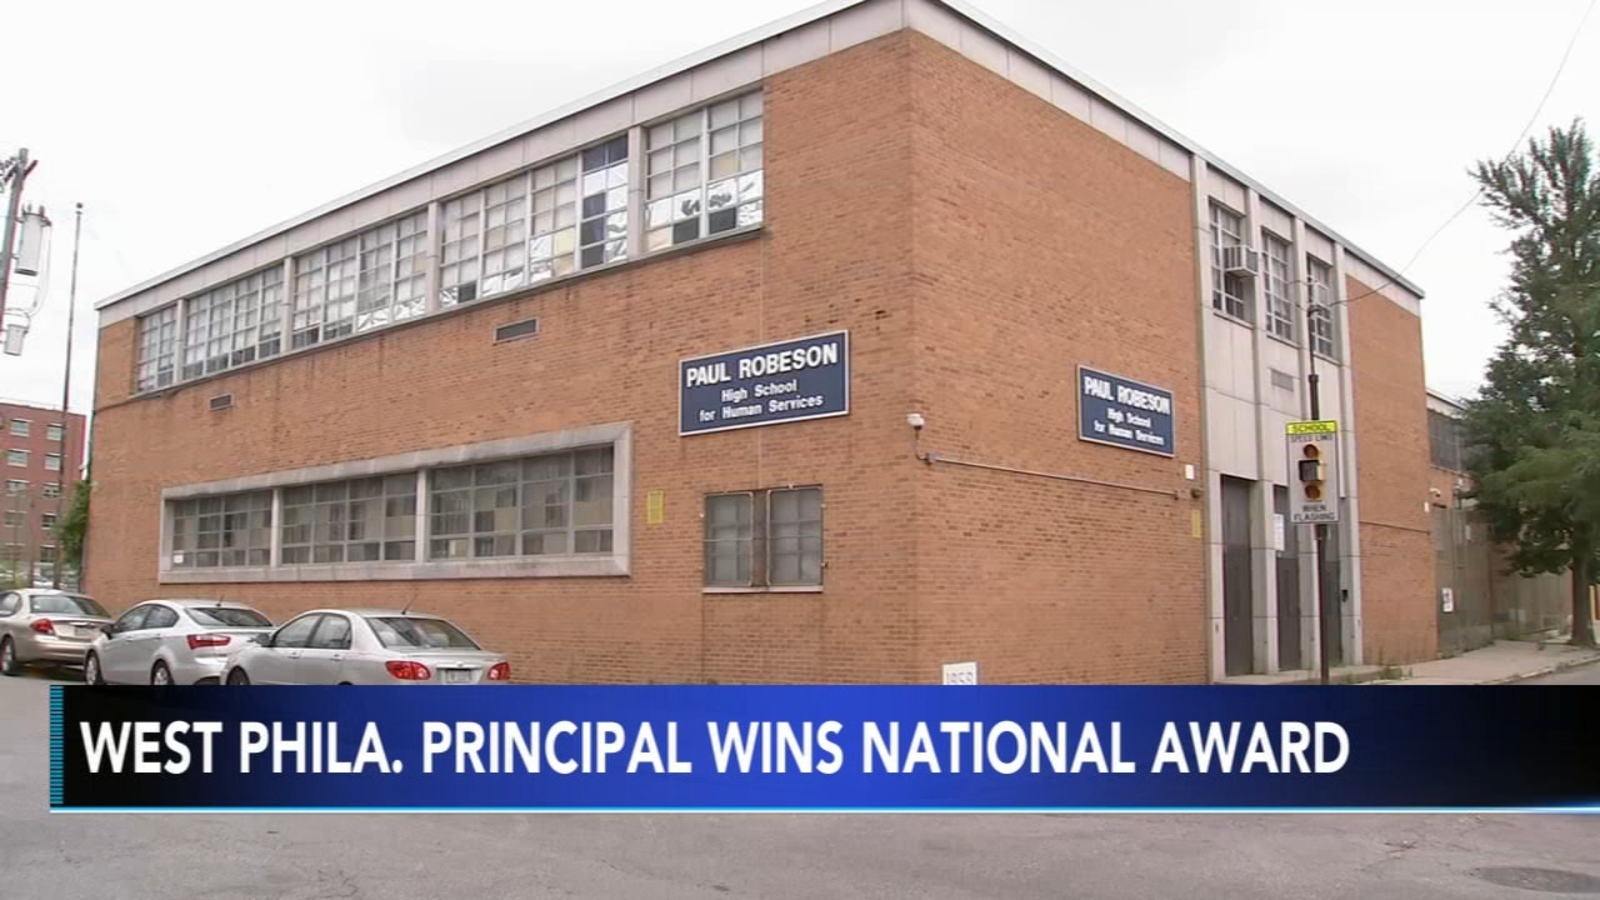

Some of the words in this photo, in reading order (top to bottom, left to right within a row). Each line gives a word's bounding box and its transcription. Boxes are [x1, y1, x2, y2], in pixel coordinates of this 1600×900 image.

[686, 362, 731, 387] PAUL
[739, 342, 838, 379] ROBESON
[721, 387, 748, 402] High
[754, 379, 797, 397] School
[1084, 376, 1115, 401] PAUL
[1117, 385, 1170, 415] ROBESON
[699, 409, 715, 422] for
[722, 404, 762, 419] Human
[768, 394, 823, 412] Services
[1292, 423, 1327, 432] SCHOOL
[1294, 512, 1335, 521] FLASHING
